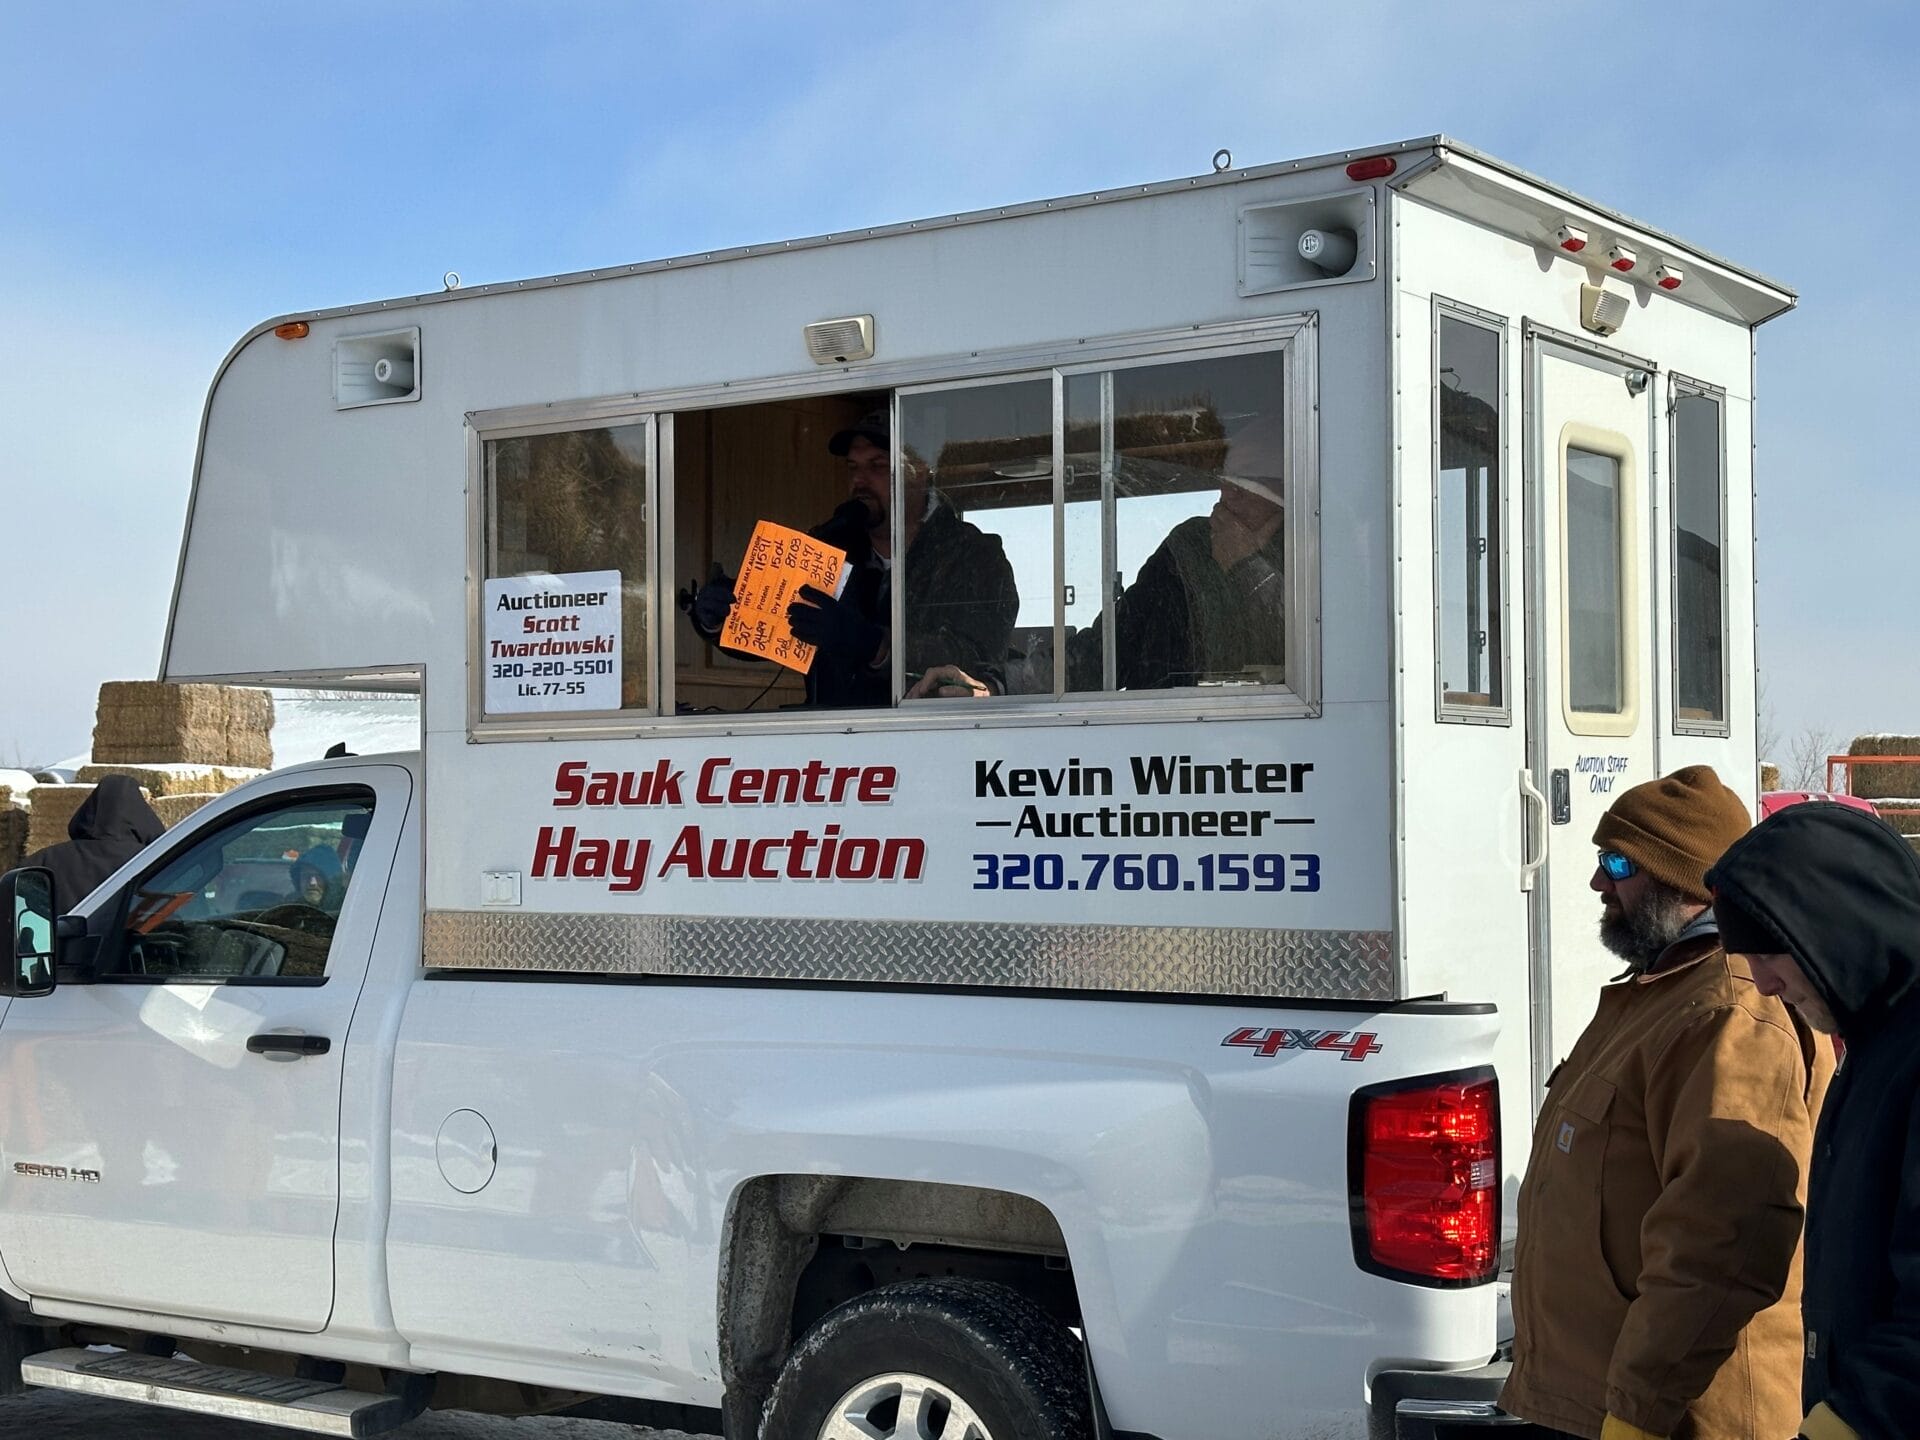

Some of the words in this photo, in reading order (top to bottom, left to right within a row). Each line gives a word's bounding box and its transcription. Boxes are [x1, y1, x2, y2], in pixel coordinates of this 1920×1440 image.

[497, 592, 607, 611] Auctioneer
[757, 585, 770, 611] Protein
[775, 579, 787, 602] Matter
[771, 601, 781, 614] Dry
[523, 615, 580, 633] Scott
[491, 635, 614, 658] Twardowski
[492, 660, 613, 678] 320-220-5501
[1575, 755, 1605, 773] AUCTION
[1607, 755, 1628, 772] STAFF
[552, 759, 685, 807] Sauk
[695, 757, 897, 805] Centre
[975, 758, 1112, 797] Kevin
[1130, 755, 1314, 795] Winter
[1590, 774, 1615, 793] ONLY
[530, 826, 651, 893] Hay
[657, 824, 925, 880] Auction
[972, 853, 1321, 892] 320.760.1593
